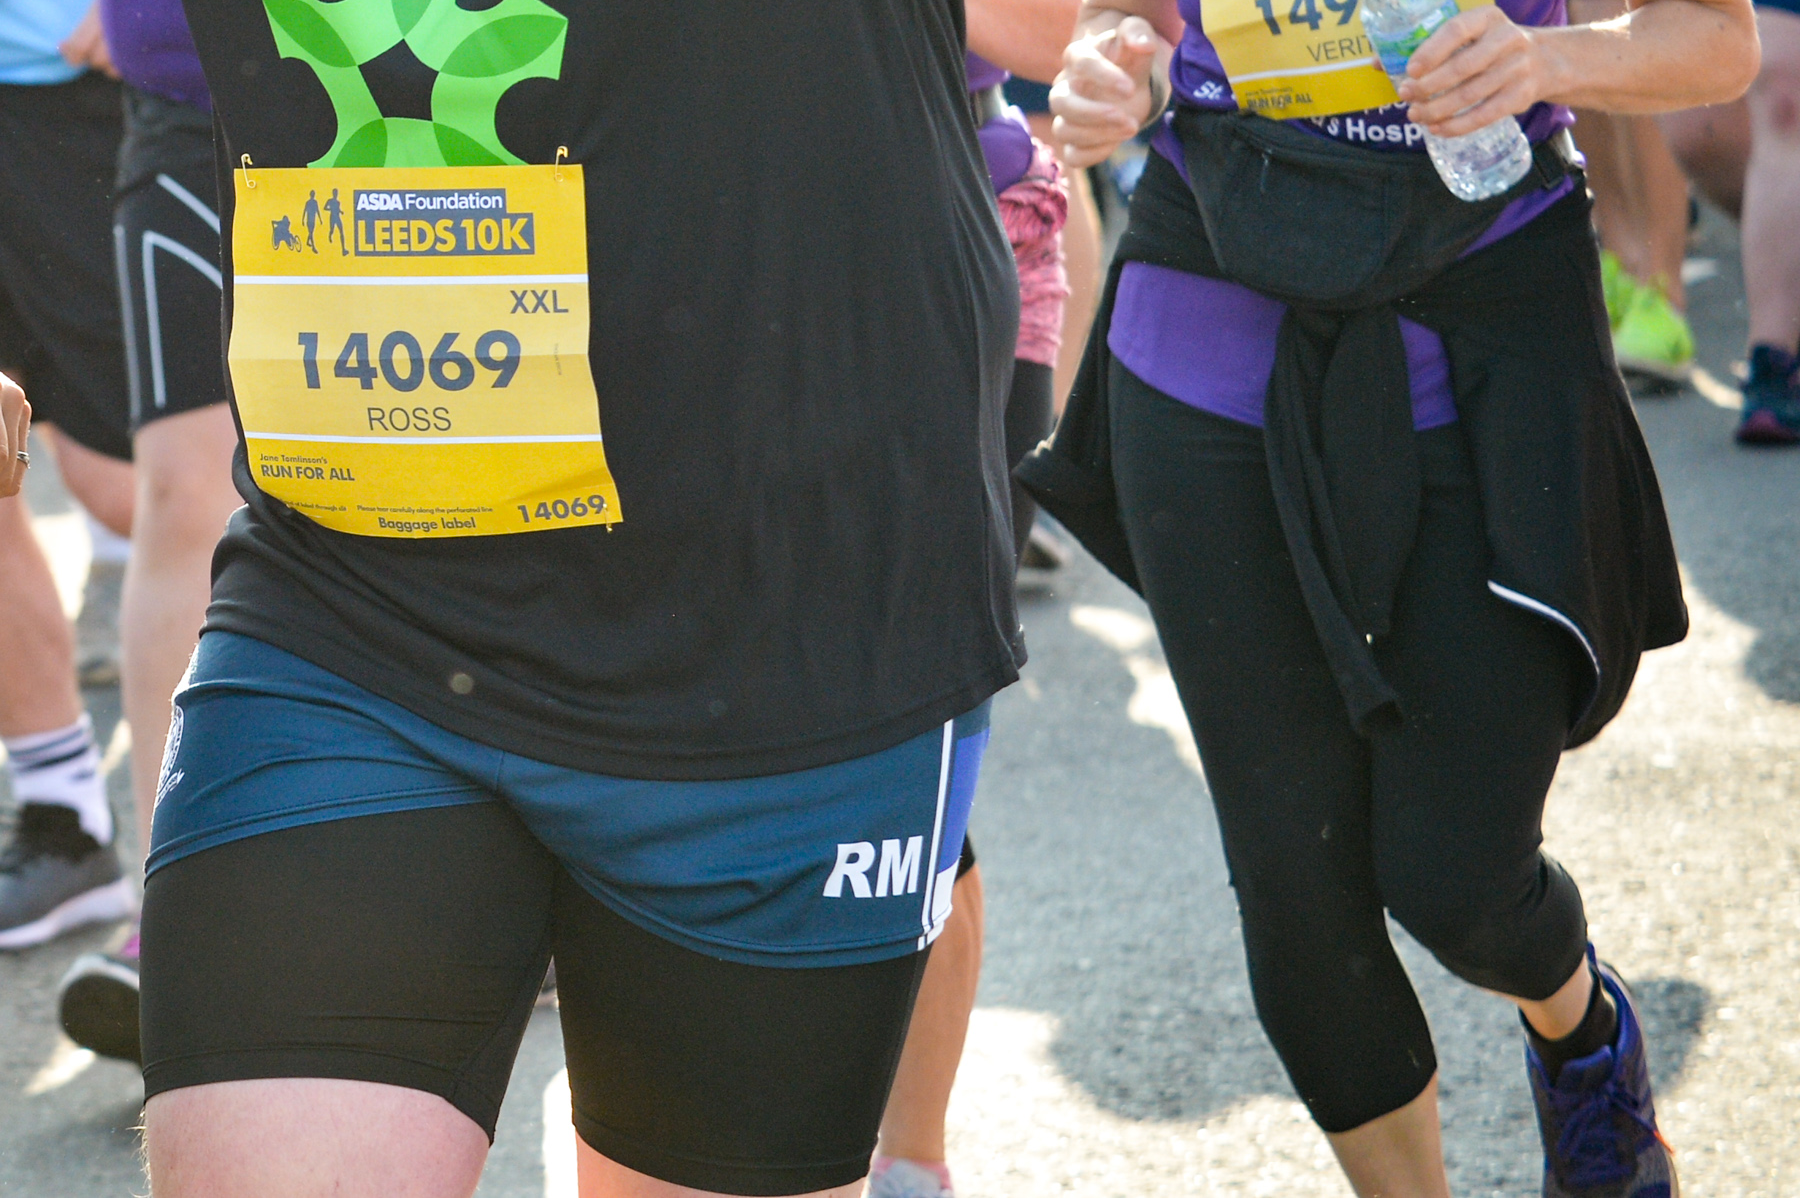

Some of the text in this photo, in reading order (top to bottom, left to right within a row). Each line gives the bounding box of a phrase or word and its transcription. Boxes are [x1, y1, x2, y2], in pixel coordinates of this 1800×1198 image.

[1306, 34, 1373, 62] VERIT
[1345, 115, 1428, 147] Hosp
[356, 191, 503, 211] ASDA Foundation
[357, 217, 531, 252] LEEDS 10K
[509, 289, 570, 314] XXL
[297, 329, 522, 393] 14069
[366, 406, 453, 432] ROSS
[260, 453, 328, 465] Jane Tomlinson's
[260, 464, 356, 481] RUN FOR ALL
[356, 504, 376, 512] Please
[416, 506, 435, 514] along
[446, 506, 480, 514] perforated
[517, 494, 606, 523] 14069
[378, 516, 476, 533] Baggage label
[822, 834, 924, 899] RM
